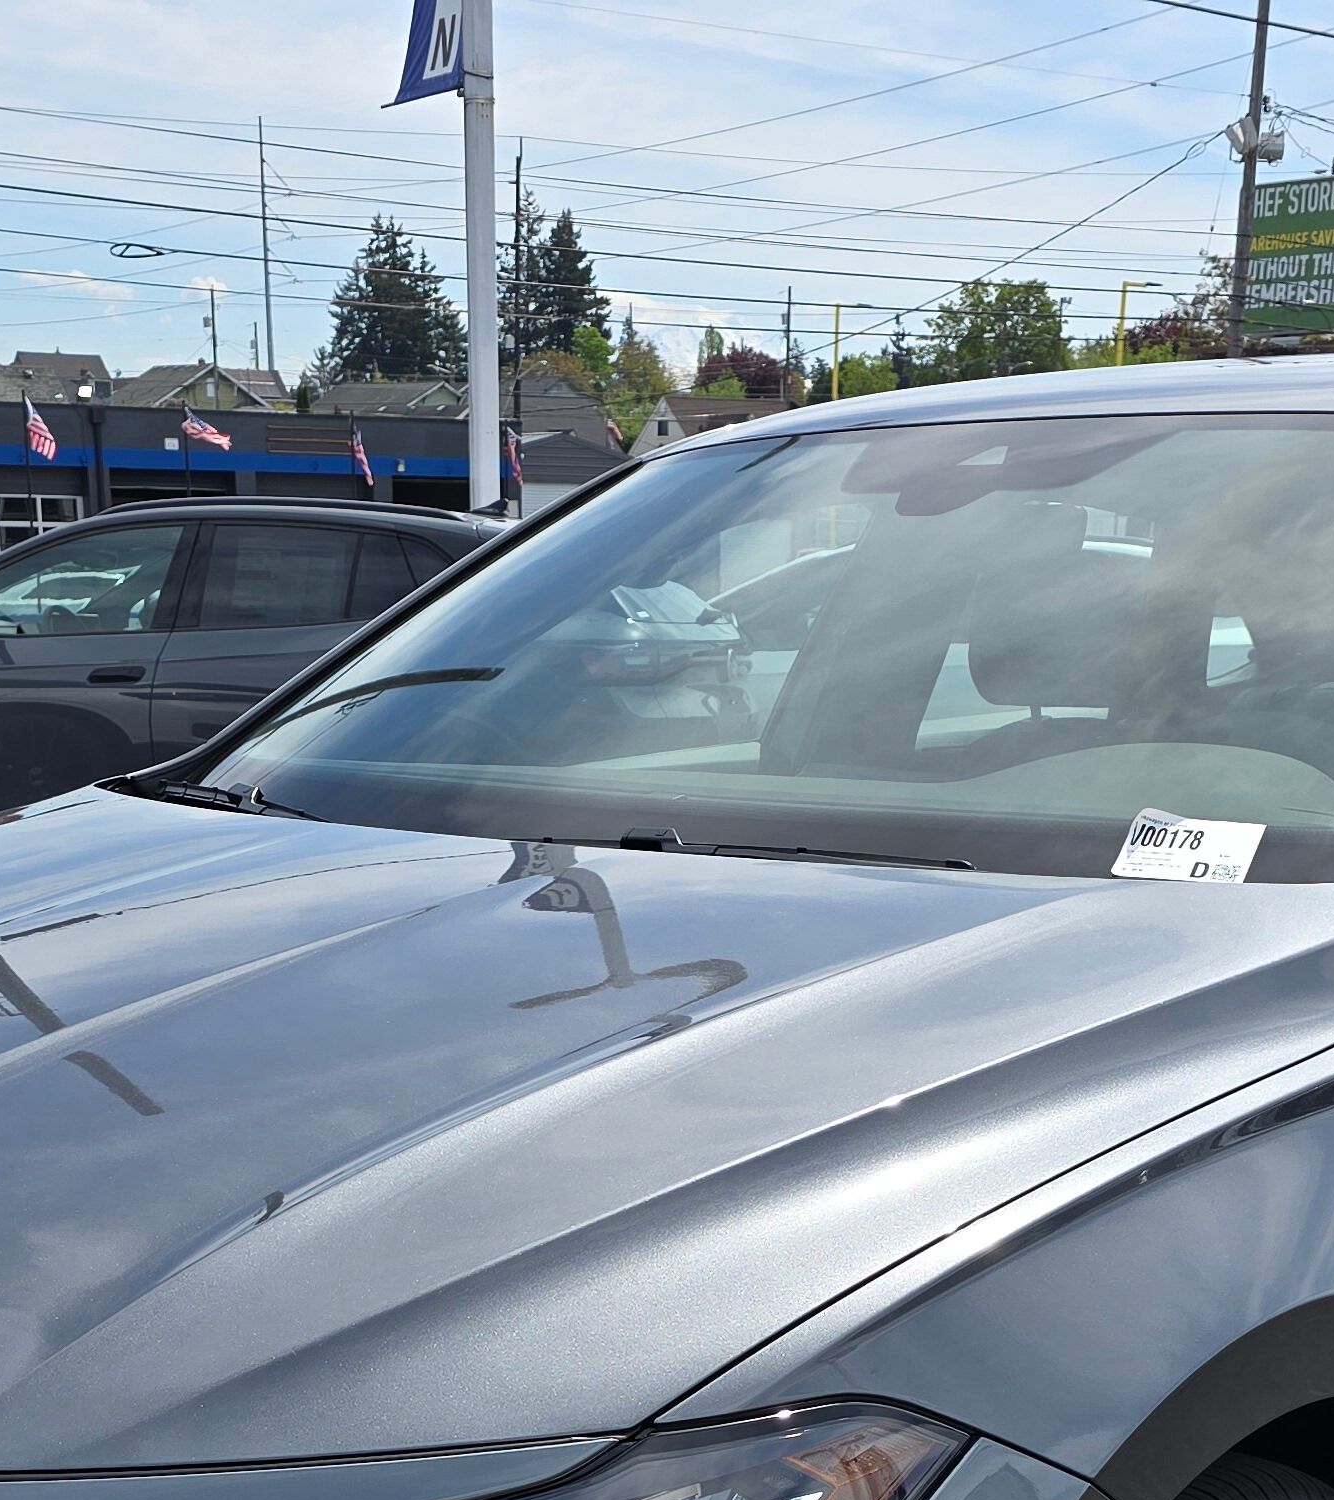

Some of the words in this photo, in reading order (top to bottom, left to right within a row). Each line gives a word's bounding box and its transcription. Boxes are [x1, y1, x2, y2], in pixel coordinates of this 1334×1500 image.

[430, 13, 457, 72] N
[1249, 231, 1309, 252] AREHOUSE
[1130, 821, 1205, 850] V00178
[1190, 862, 1210, 878] D
